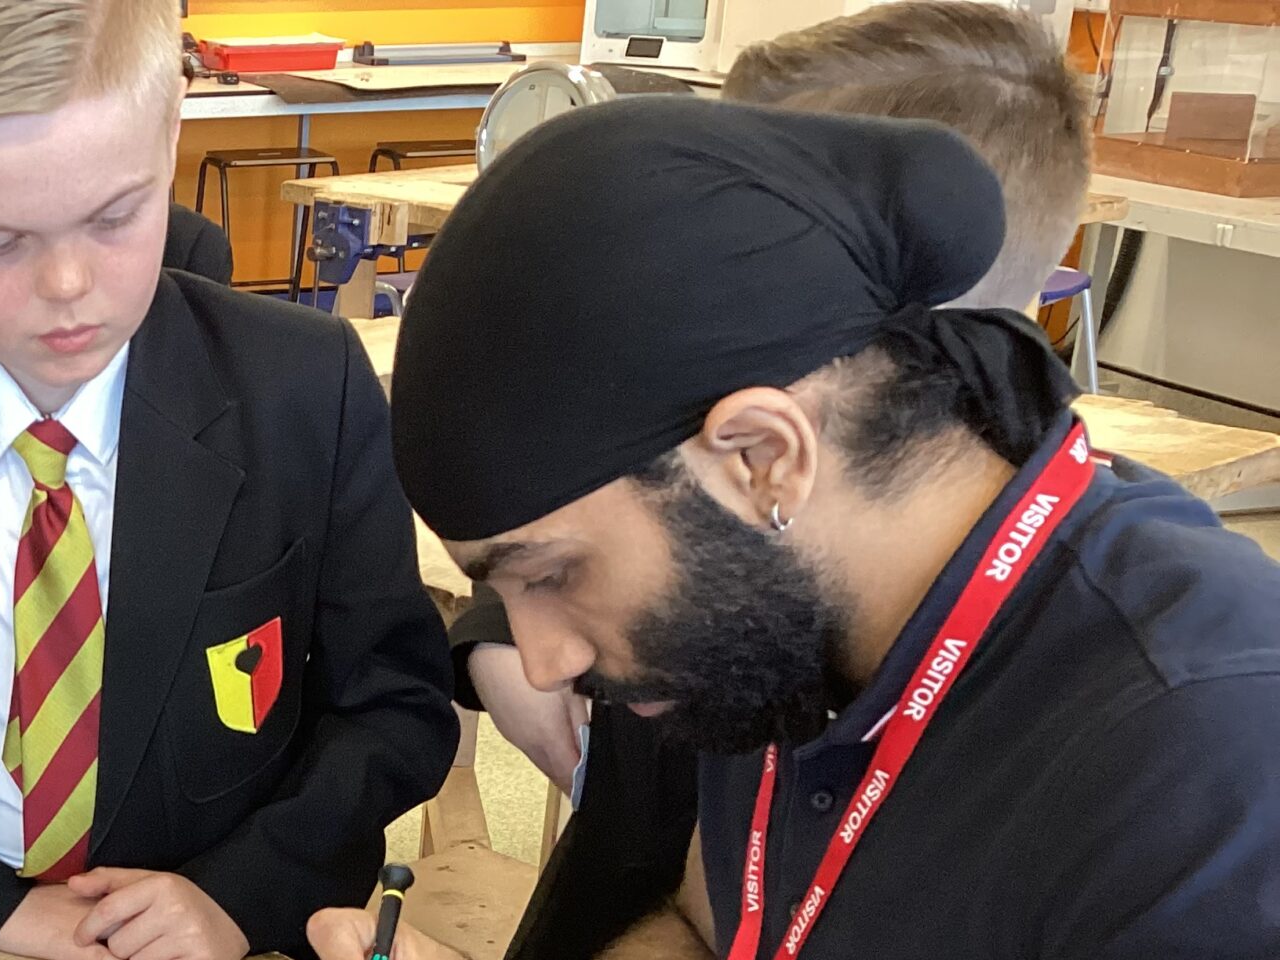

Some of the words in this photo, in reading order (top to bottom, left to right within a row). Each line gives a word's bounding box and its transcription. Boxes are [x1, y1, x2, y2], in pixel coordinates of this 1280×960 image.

[985, 493, 1060, 582] VISITOR
[903, 638, 967, 721] VISITOR
[839, 769, 890, 844] VISITOR
[747, 831, 762, 912] VISITOR
[785, 886, 825, 955] VISITOR
